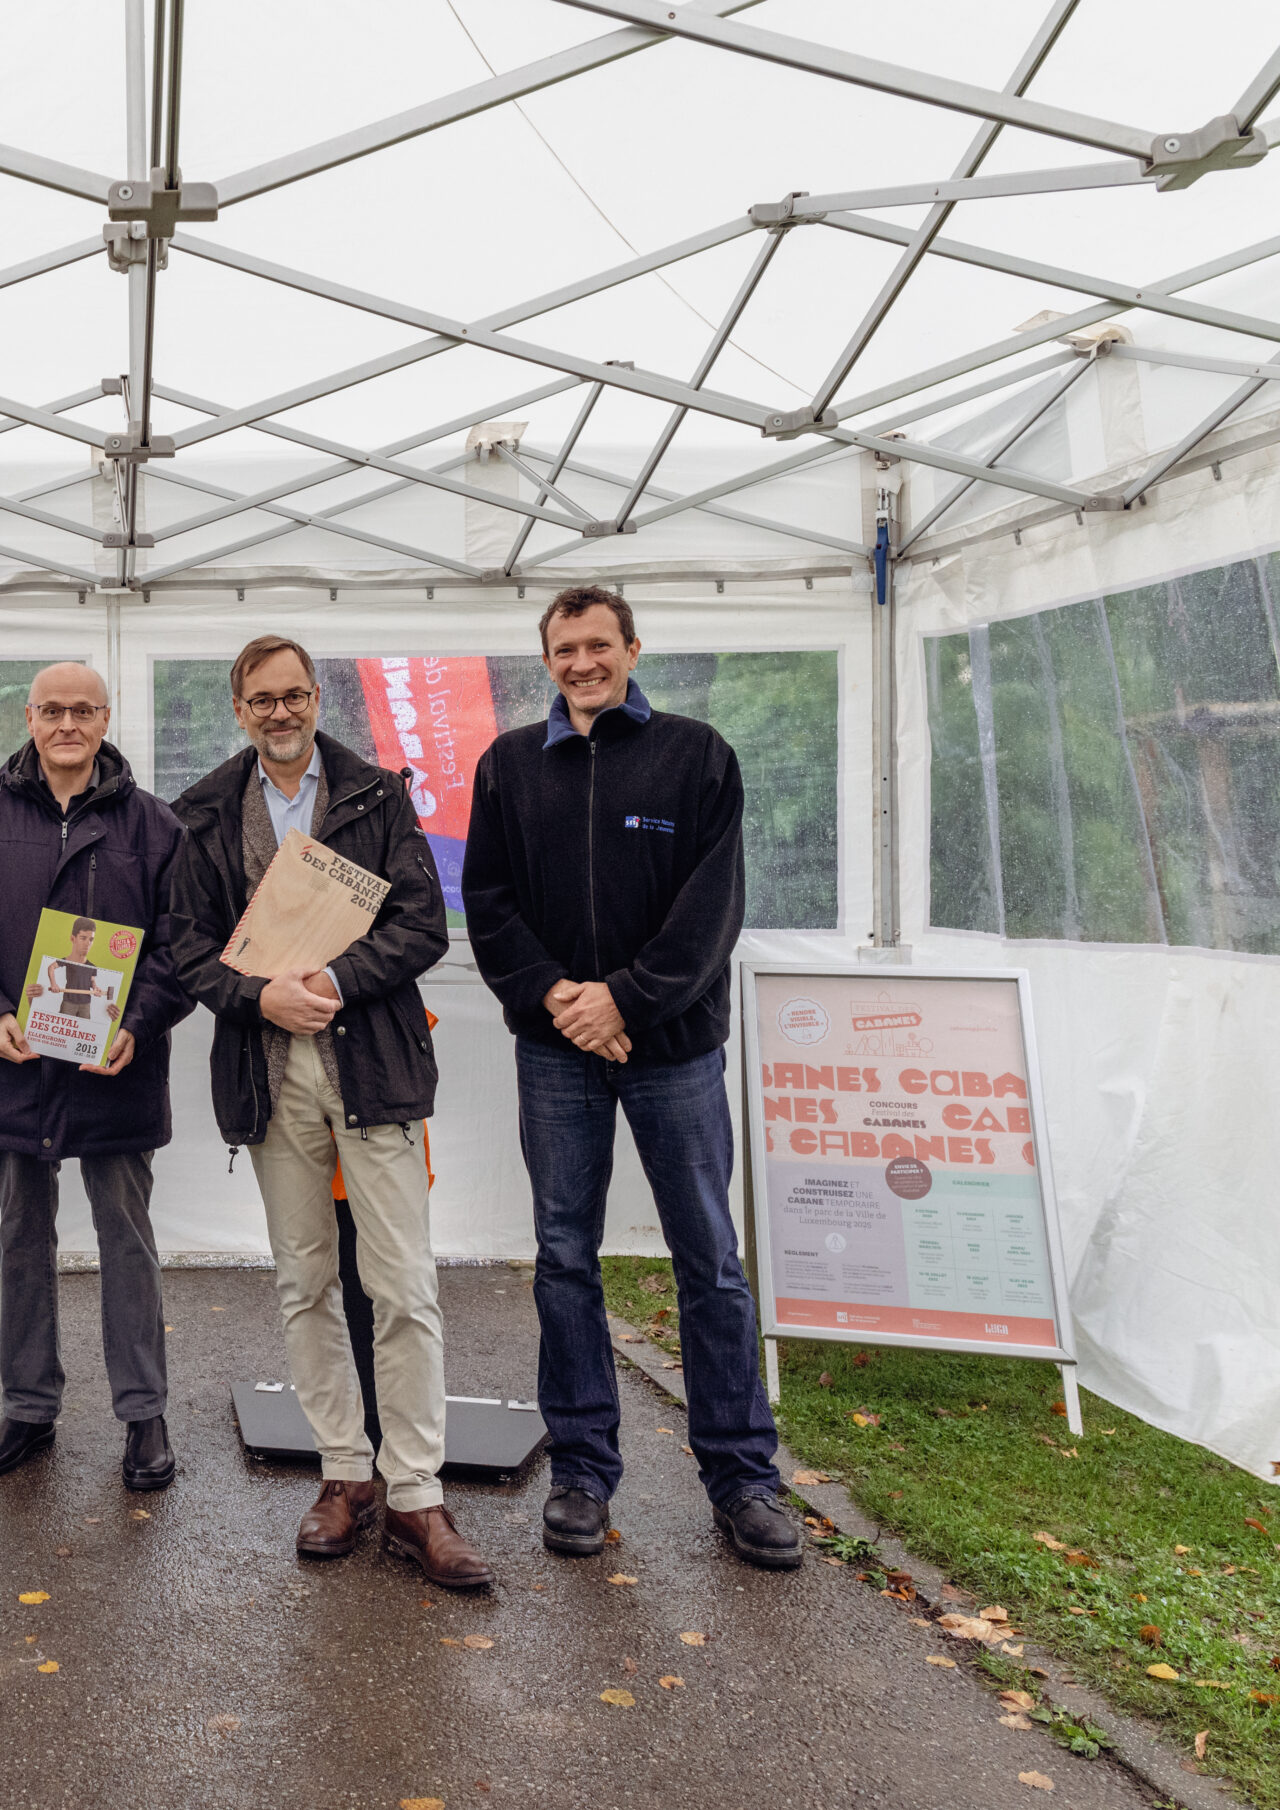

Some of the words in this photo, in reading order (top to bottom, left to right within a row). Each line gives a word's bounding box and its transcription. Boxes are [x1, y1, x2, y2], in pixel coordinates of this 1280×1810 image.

[301, 852, 327, 872] DES
[331, 856, 389, 896] FESTIVAL
[350, 894, 380, 915] 2010
[32, 1011, 79, 1029] FESTIVAL
[855, 1015, 917, 1029] CABANES
[30, 1020, 50, 1032] DES
[51, 1025, 97, 1042] CABANES
[75, 1042, 98, 1055] 2013
[869, 1100, 918, 1109] CONCOURS
[871, 1109, 901, 1117] Festival
[863, 1117, 926, 1129] CABANES
[789, 1128, 995, 1165] CABANES
[804, 1178, 849, 1188] IMAGINEZ
[792, 1187, 854, 1198] CONSTRUISEZ
[855, 1191, 873, 1199] UNE
[787, 1196, 824, 1205] CABANE
[825, 1199, 881, 1209] TEMPORAIRE
[783, 1206, 803, 1214] dans
[805, 1206, 813, 1214] le
[814, 1208, 832, 1217] parc
[833, 1208, 845, 1216] de
[846, 1208, 854, 1217] la
[855, 1209, 874, 1218] Ville
[875, 1210, 886, 1219] de
[799, 1217, 852, 1228] Luxembourg
[853, 1221, 872, 1229] 2025
